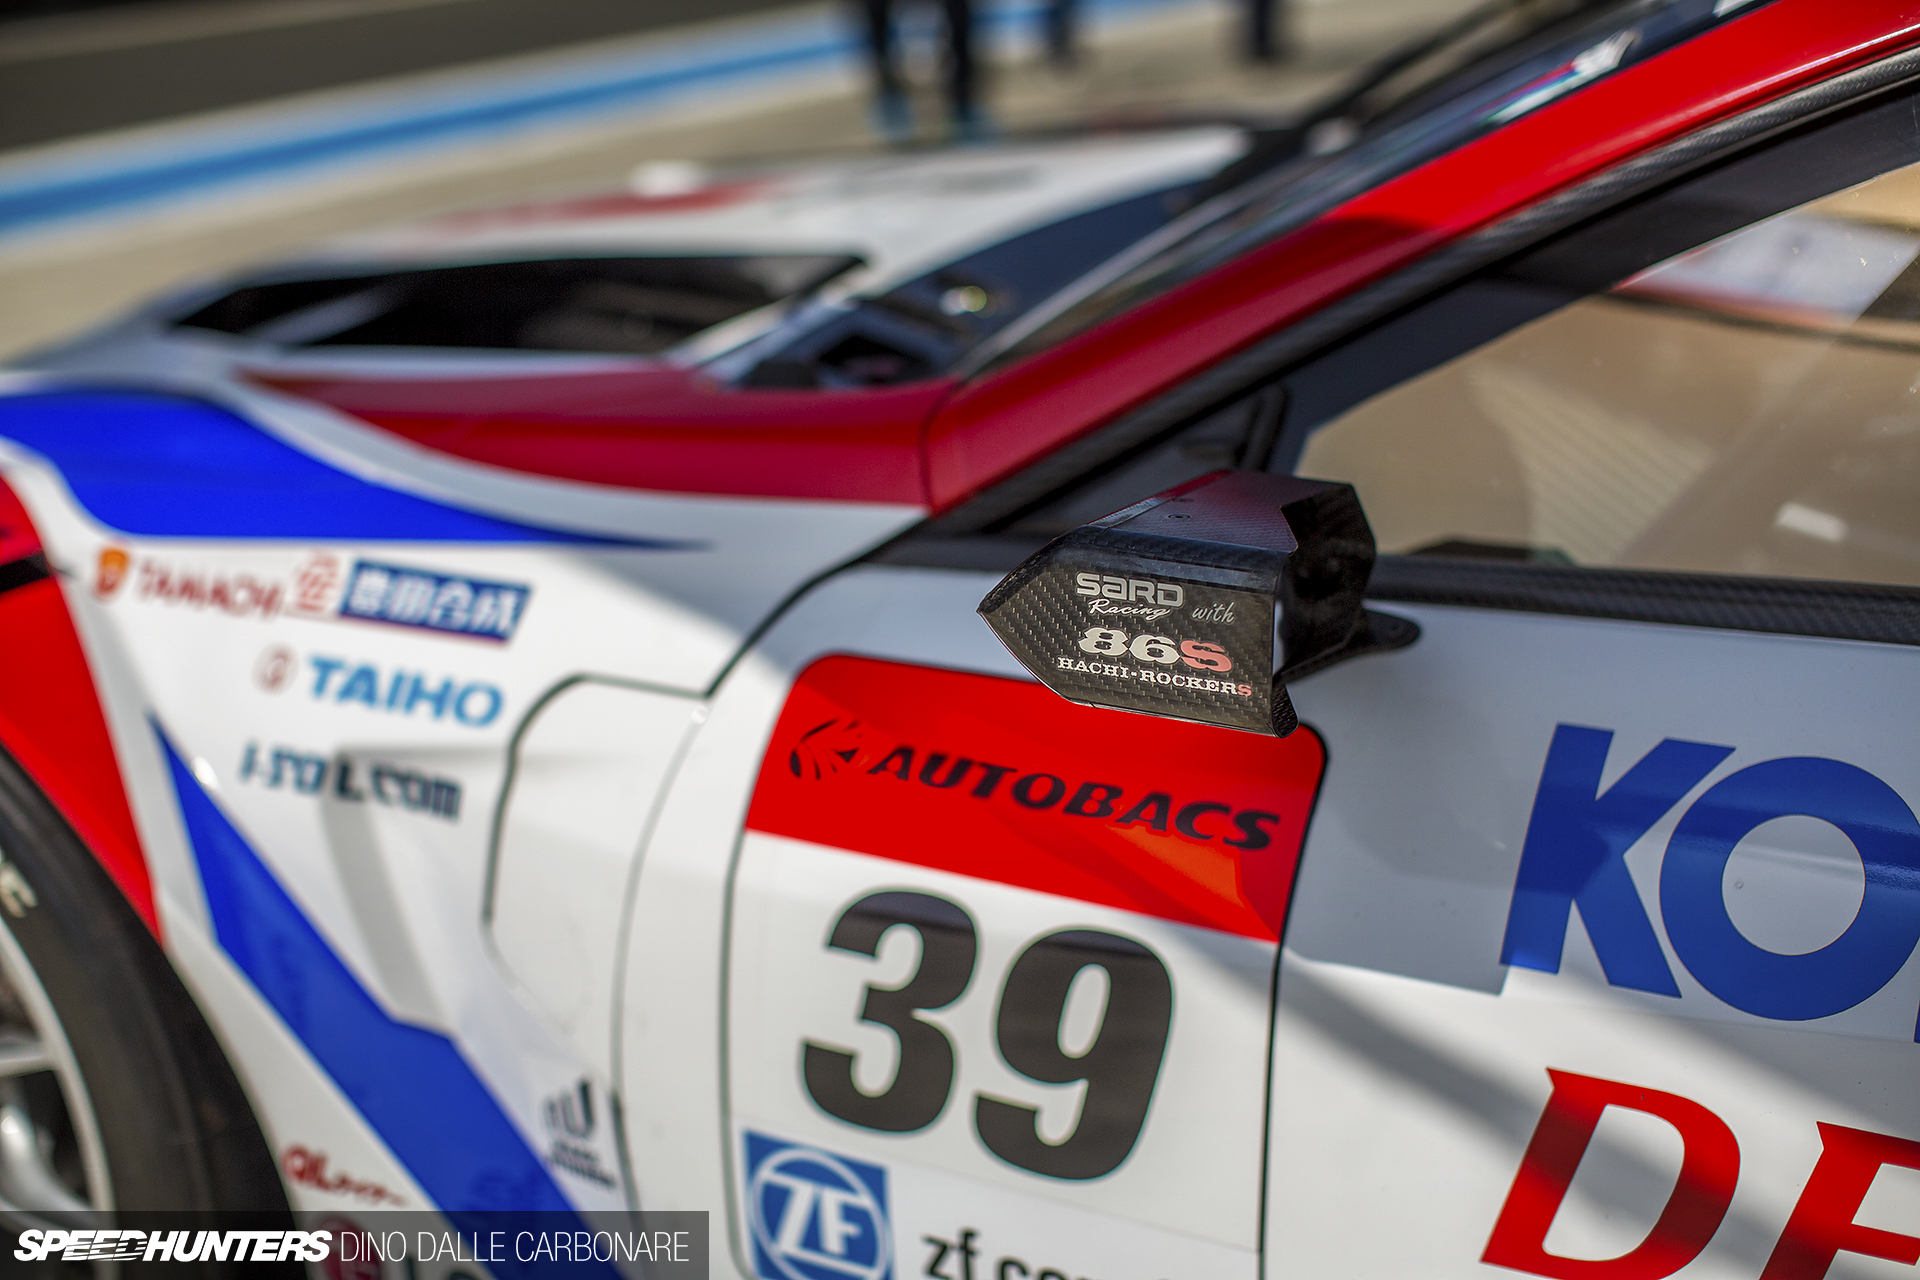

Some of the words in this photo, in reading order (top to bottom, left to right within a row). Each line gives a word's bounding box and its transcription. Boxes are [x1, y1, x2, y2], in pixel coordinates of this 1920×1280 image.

[1077, 626, 1232, 672] 86S
[1087, 598, 1171, 621] Racing
[1191, 602, 1235, 623] with
[307, 655, 503, 728] TAIHO
[865, 742, 1280, 851] AUTOBACS
[1499, 721, 1920, 1044] KO
[803, 889, 1174, 1180] 39
[765, 1169, 882, 1279] ZF
